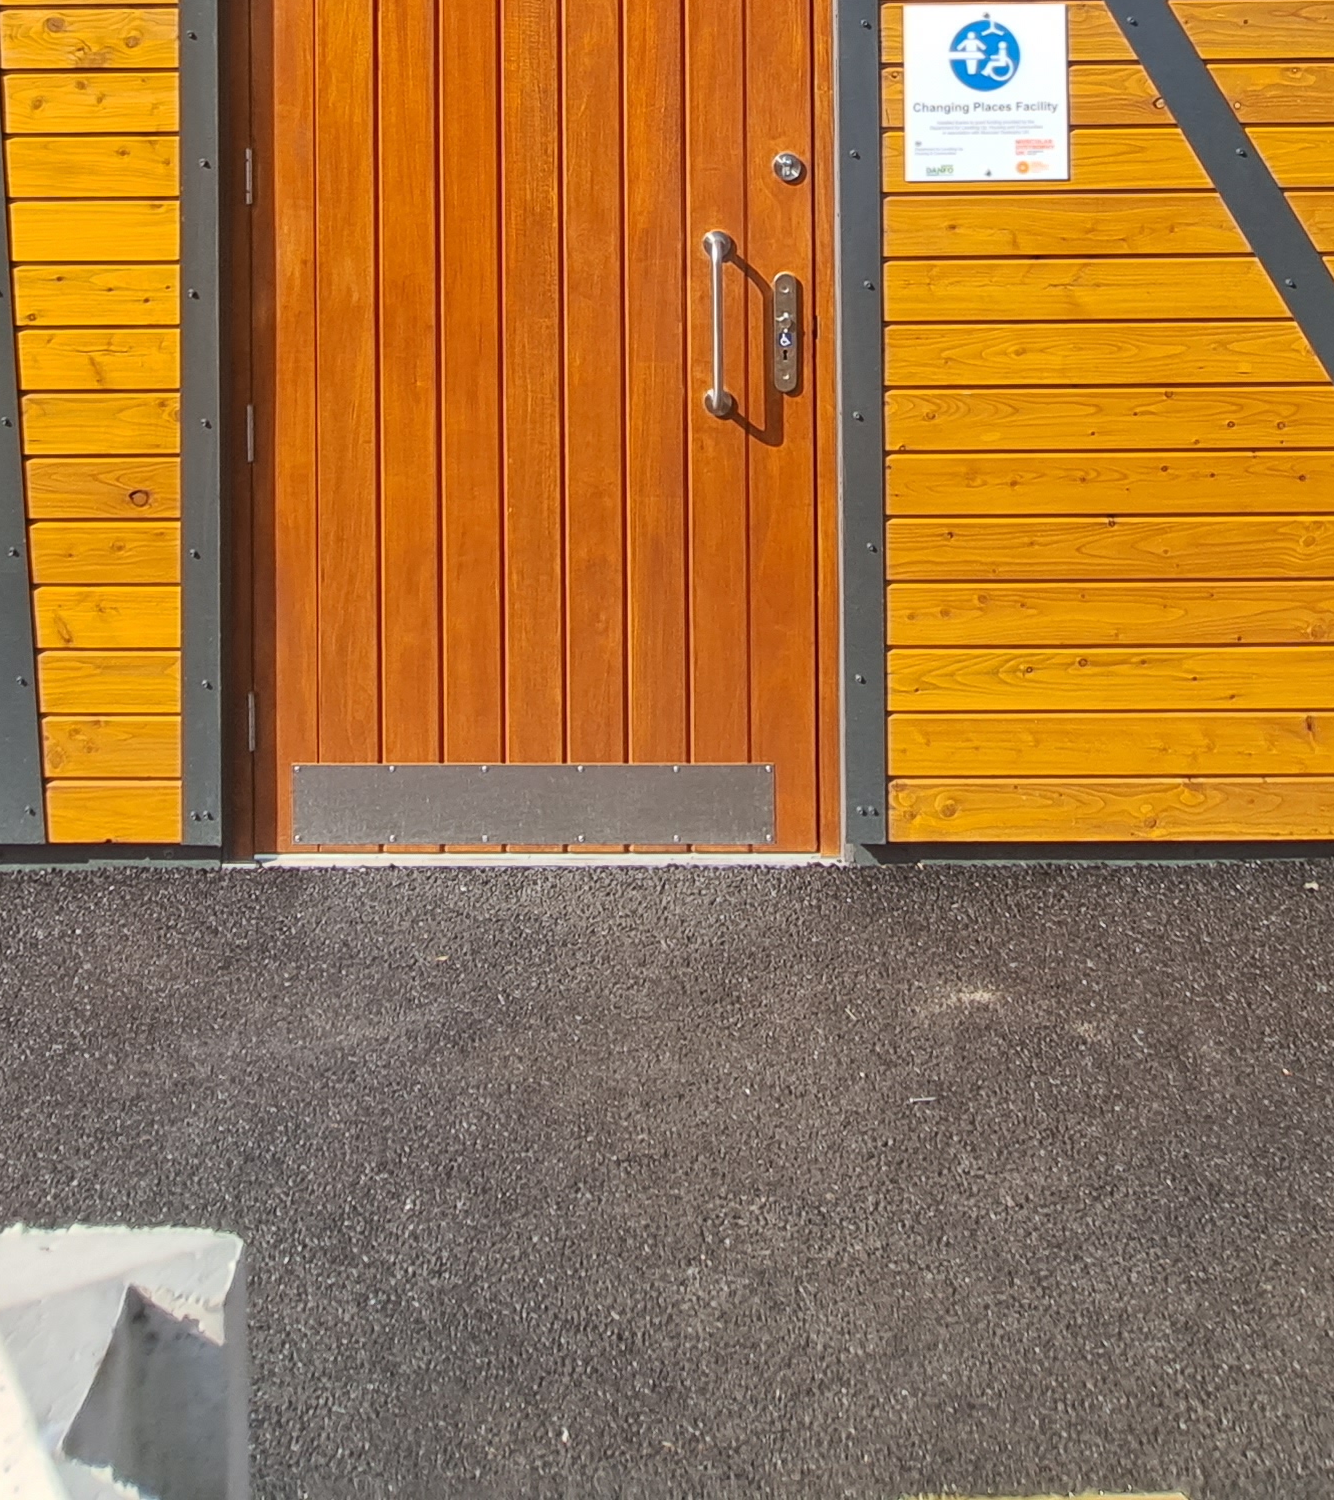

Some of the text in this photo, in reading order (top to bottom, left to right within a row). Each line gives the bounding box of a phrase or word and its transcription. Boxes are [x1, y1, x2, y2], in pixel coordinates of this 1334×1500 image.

[913, 101, 1058, 114] Changing Places Facility
